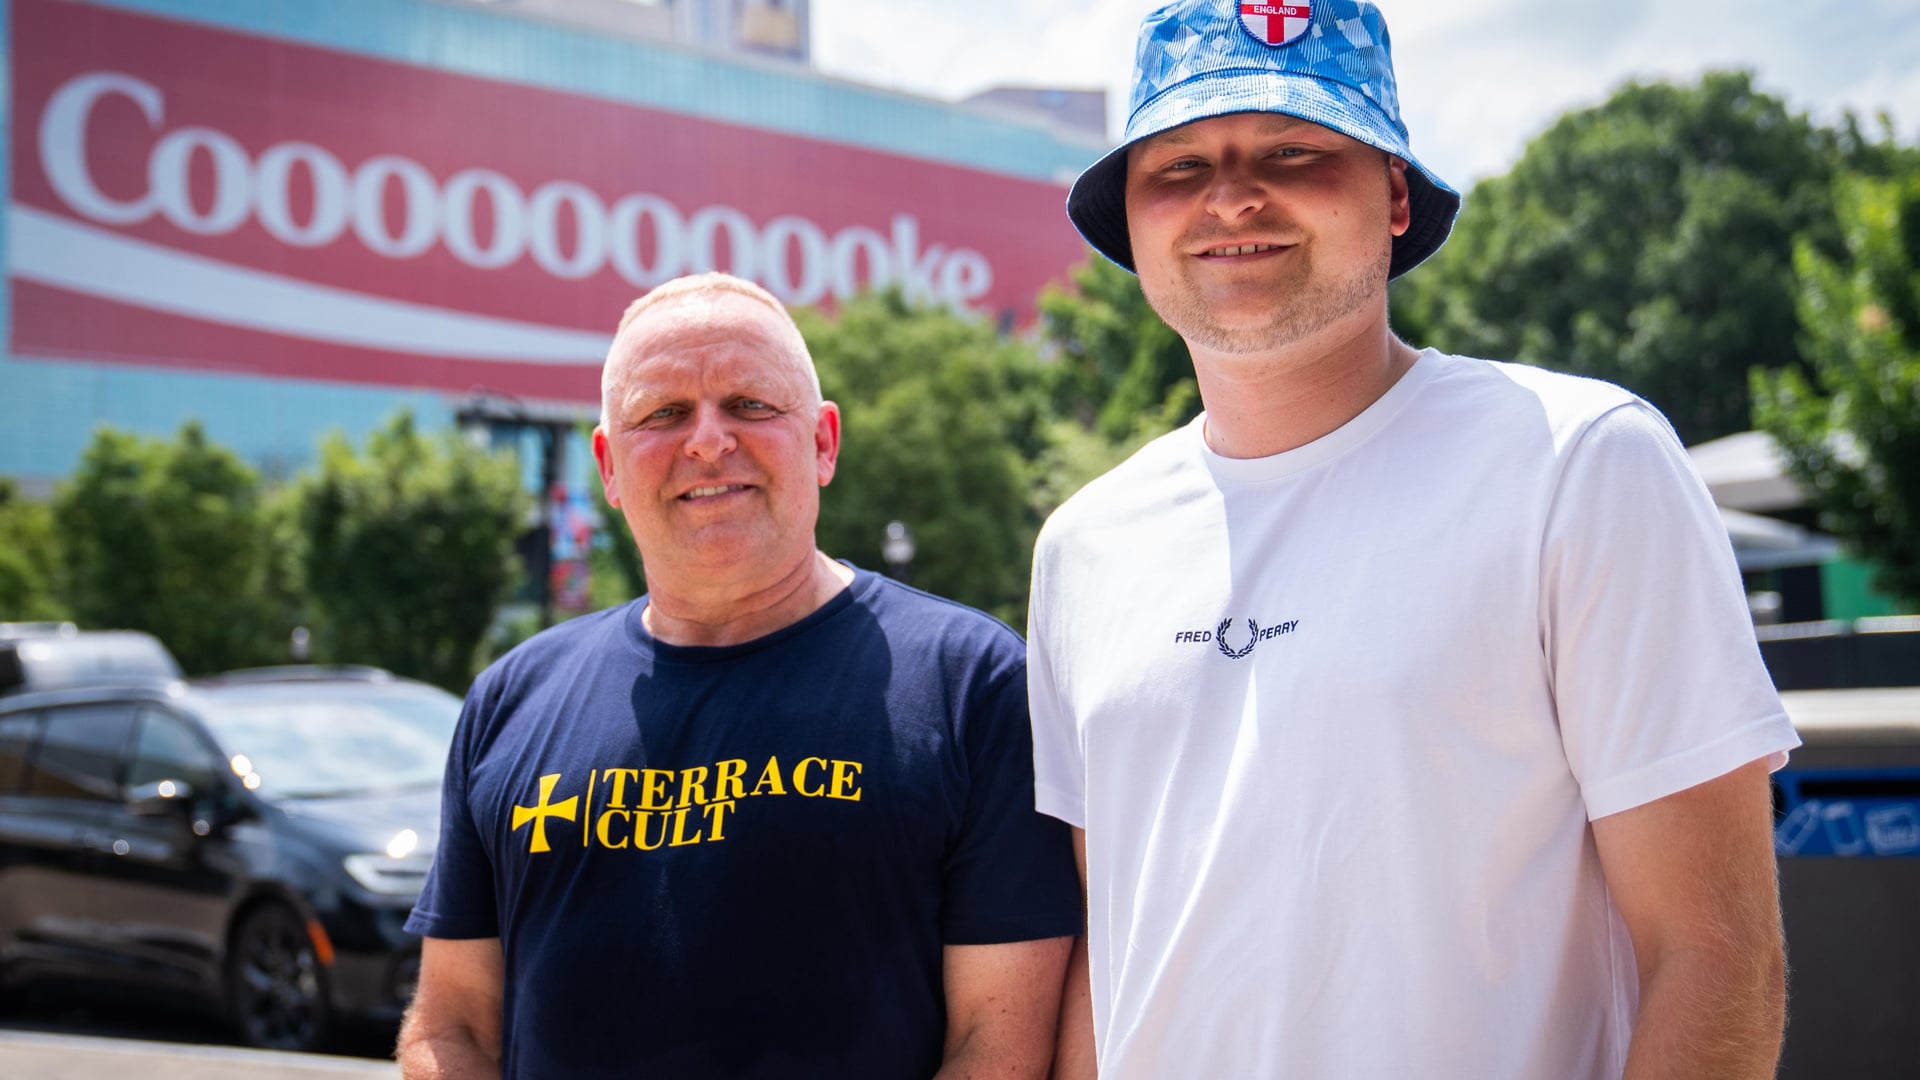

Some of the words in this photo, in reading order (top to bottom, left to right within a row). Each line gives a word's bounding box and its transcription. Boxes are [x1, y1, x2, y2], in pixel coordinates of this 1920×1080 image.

[1253, 5, 1297, 16] ENGLAND
[1174, 630, 1212, 644] FRED
[1258, 619, 1300, 642] PERRY
[602, 755, 863, 811] TERRACE
[595, 800, 736, 851] CULT
